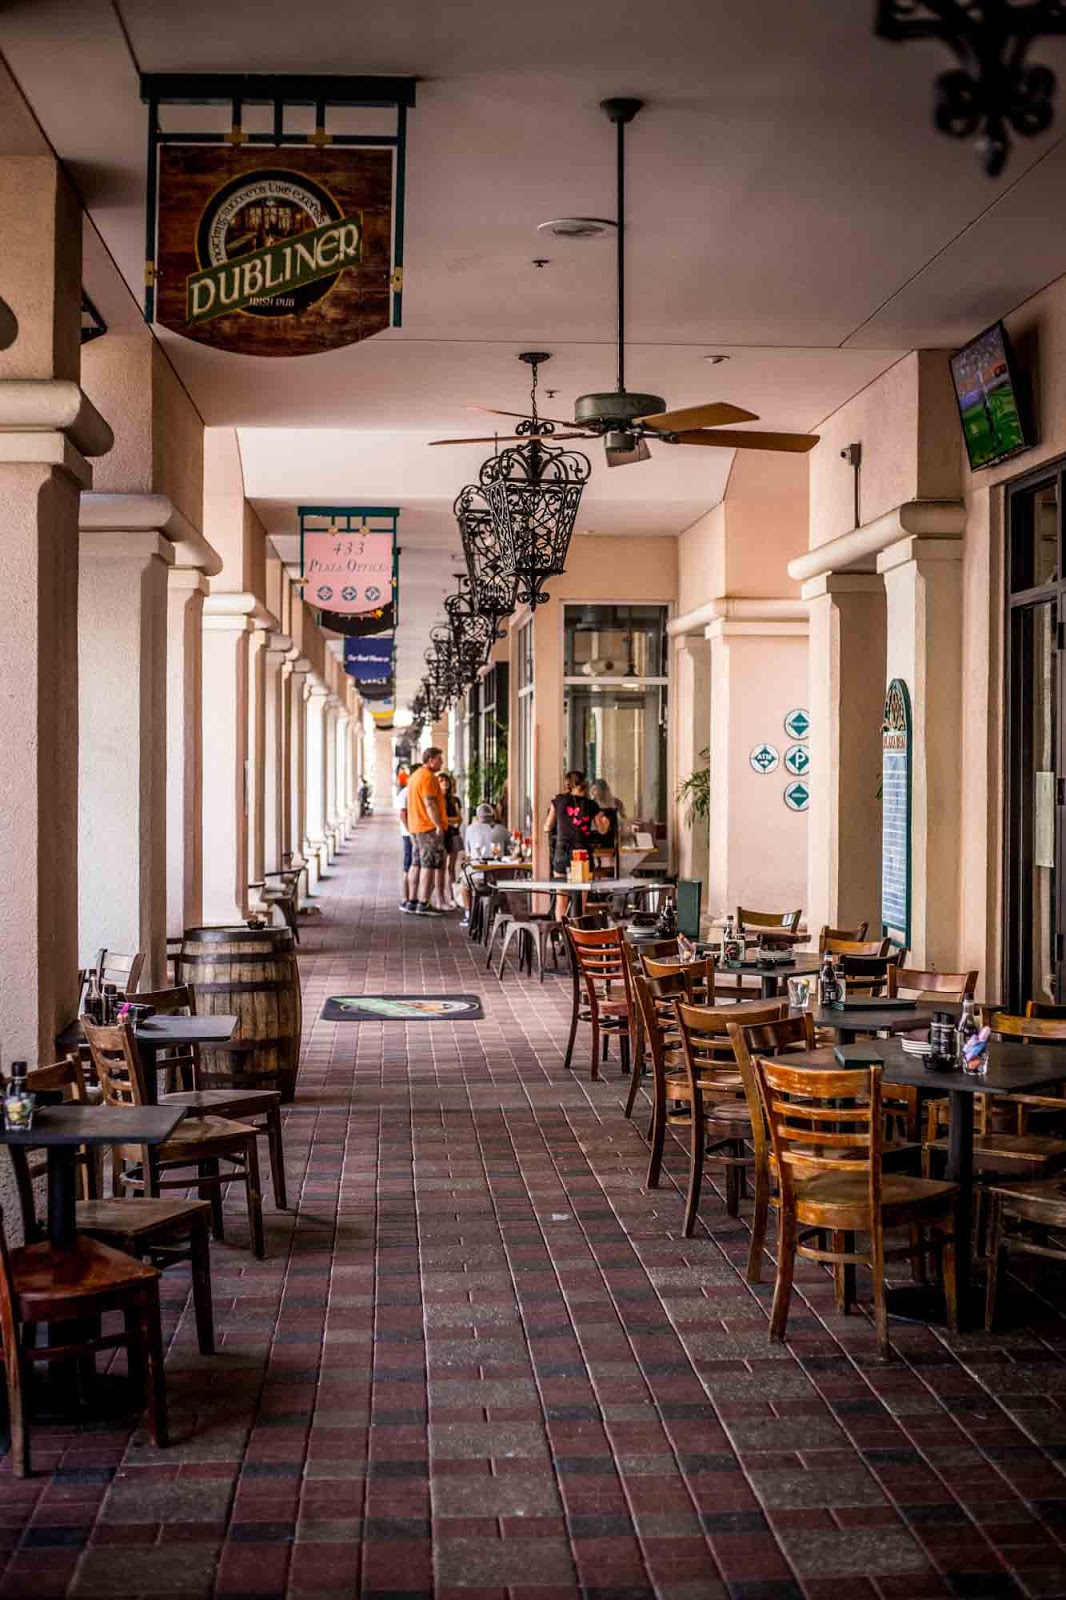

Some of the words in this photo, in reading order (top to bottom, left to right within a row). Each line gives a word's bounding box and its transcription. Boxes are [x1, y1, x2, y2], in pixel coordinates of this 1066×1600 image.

[190, 224, 358, 315] DUBLINER
[249, 296, 274, 307] IRISH
[275, 297, 295, 307] PUB
[333, 541, 365, 556] 433
[795, 751, 805, 767] P
